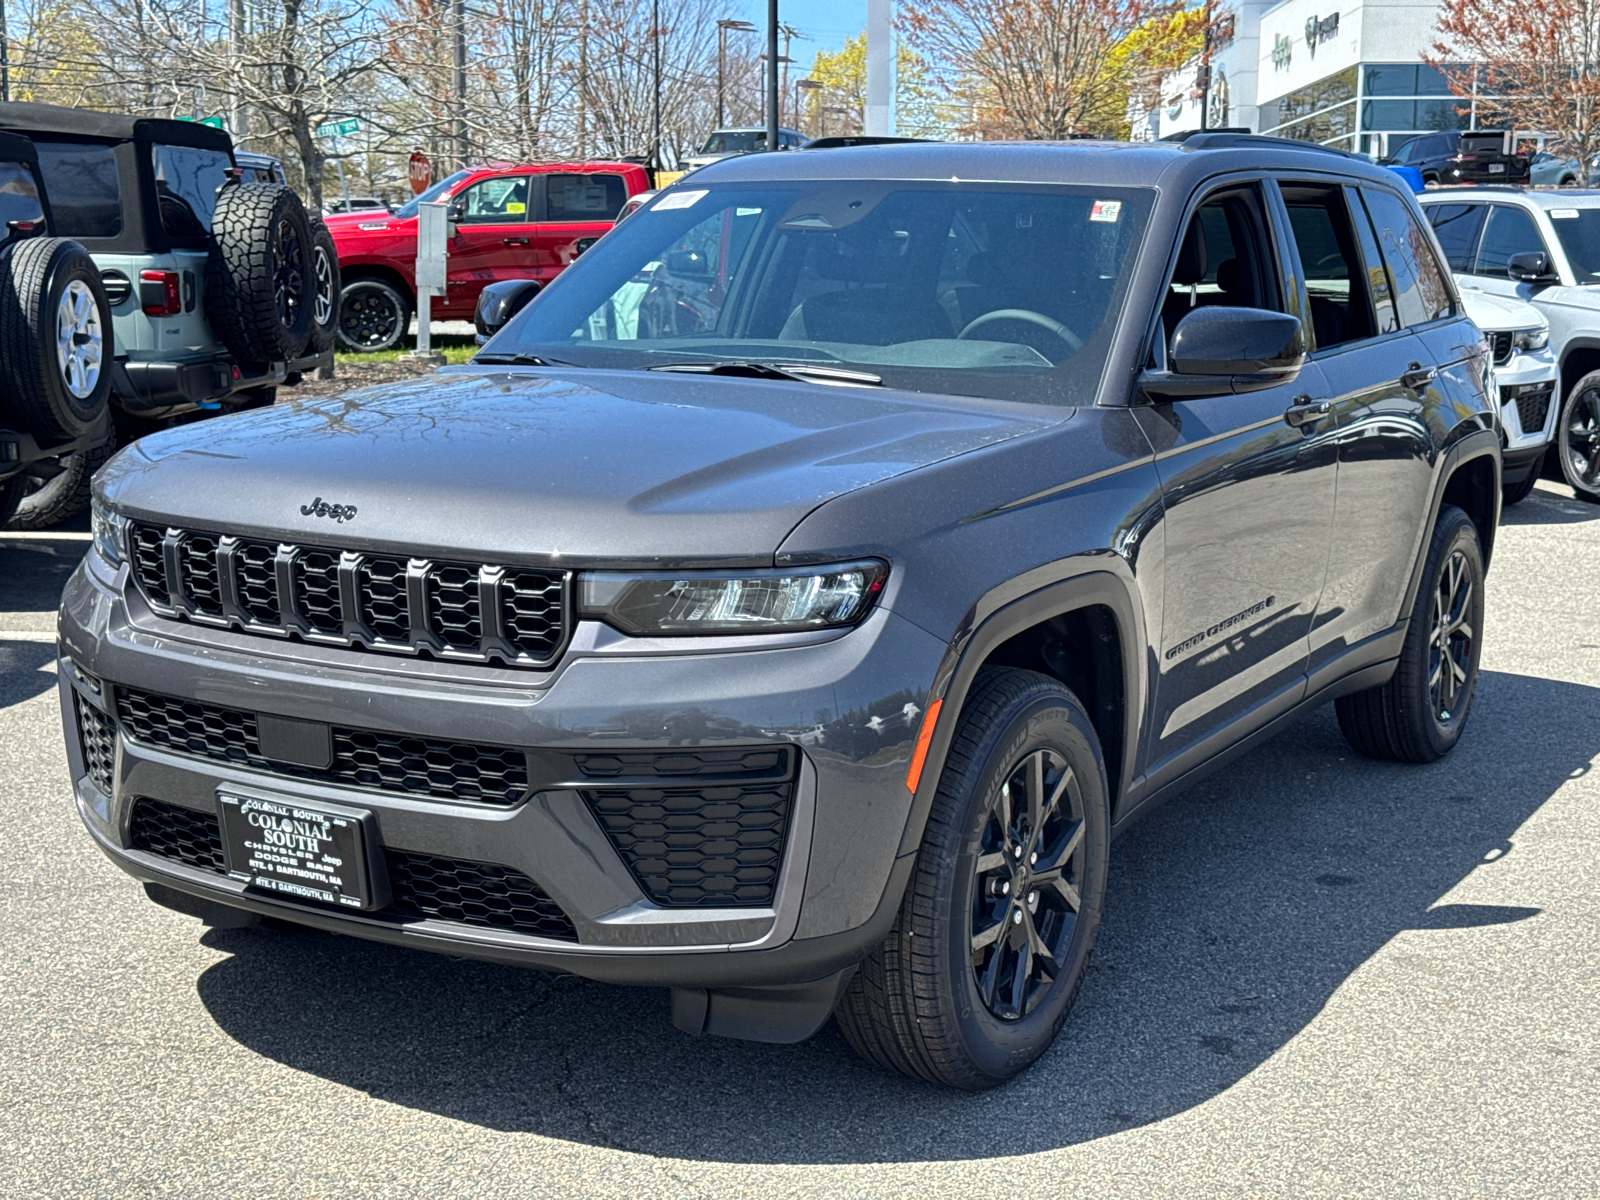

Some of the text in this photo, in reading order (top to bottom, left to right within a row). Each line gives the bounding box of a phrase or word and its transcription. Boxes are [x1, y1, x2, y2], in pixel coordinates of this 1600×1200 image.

[410, 161, 430, 181] STOP
[300, 496, 358, 524] Jeep
[1165, 600, 1266, 660] GRAND CHEROKEE
[983, 728, 1027, 809] MICHELIN
[246, 799, 289, 816] COLONIAL
[293, 809, 324, 823] SOUTH
[248, 812, 332, 842] COLONIAL
[263, 829, 320, 853] SOUTH
[244, 840, 343, 867] CHRYSLER Jeep
[254, 851, 298, 866] DODGE
[276, 865, 328, 884] DARTMOUTH,
[329, 876, 342, 886] MA
[323, 891, 334, 902] MA
